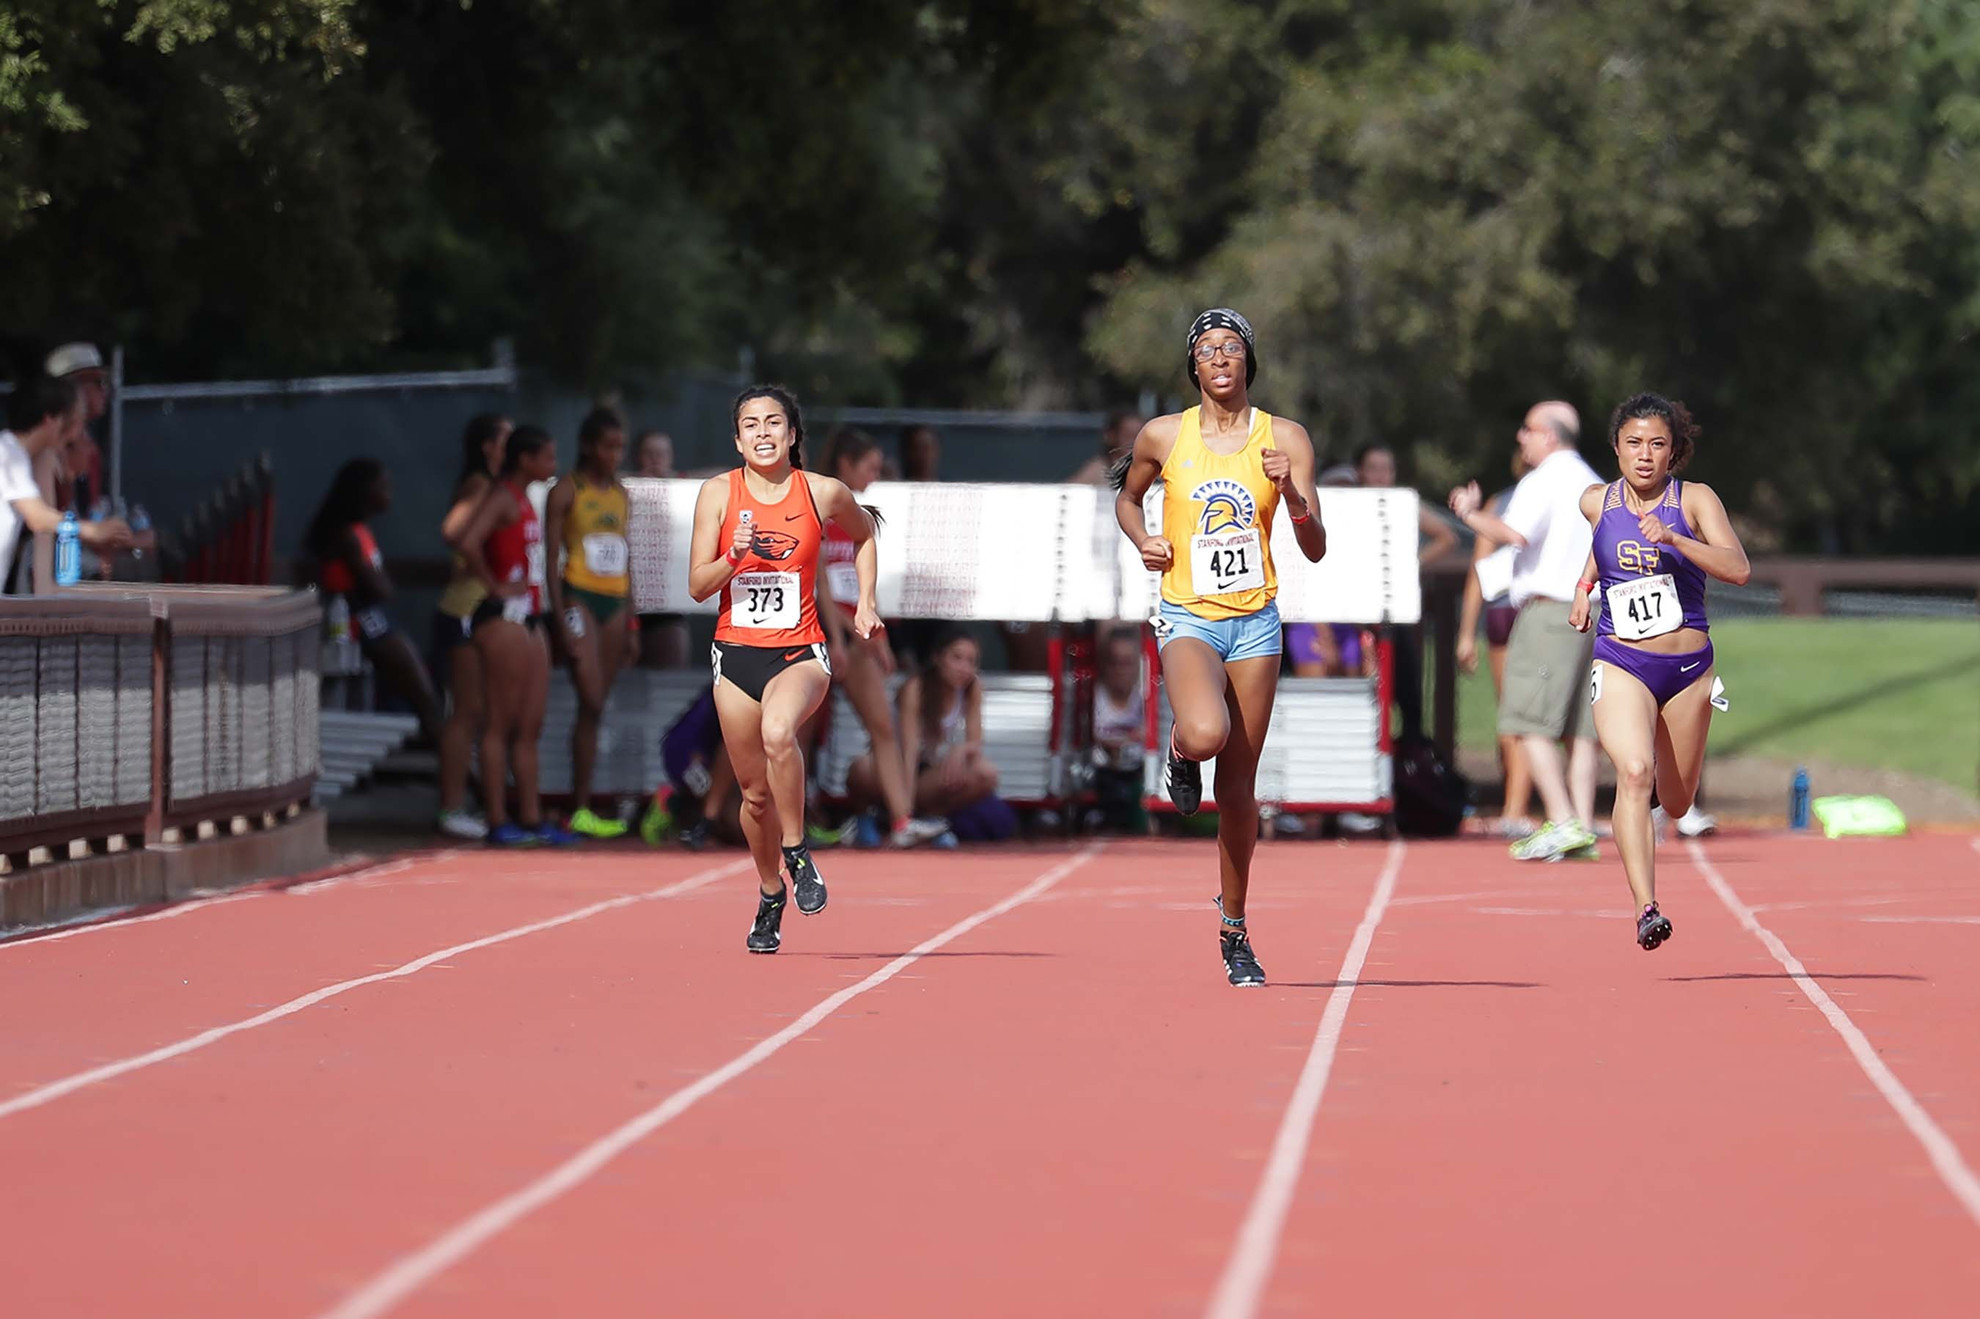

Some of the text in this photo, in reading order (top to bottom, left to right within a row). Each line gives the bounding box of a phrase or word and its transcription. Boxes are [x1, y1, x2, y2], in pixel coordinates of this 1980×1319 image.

[1210, 547, 1249, 578] 421
[1617, 541, 1660, 576] SF
[747, 587, 784, 613] 373
[1628, 592, 1662, 623] 417
